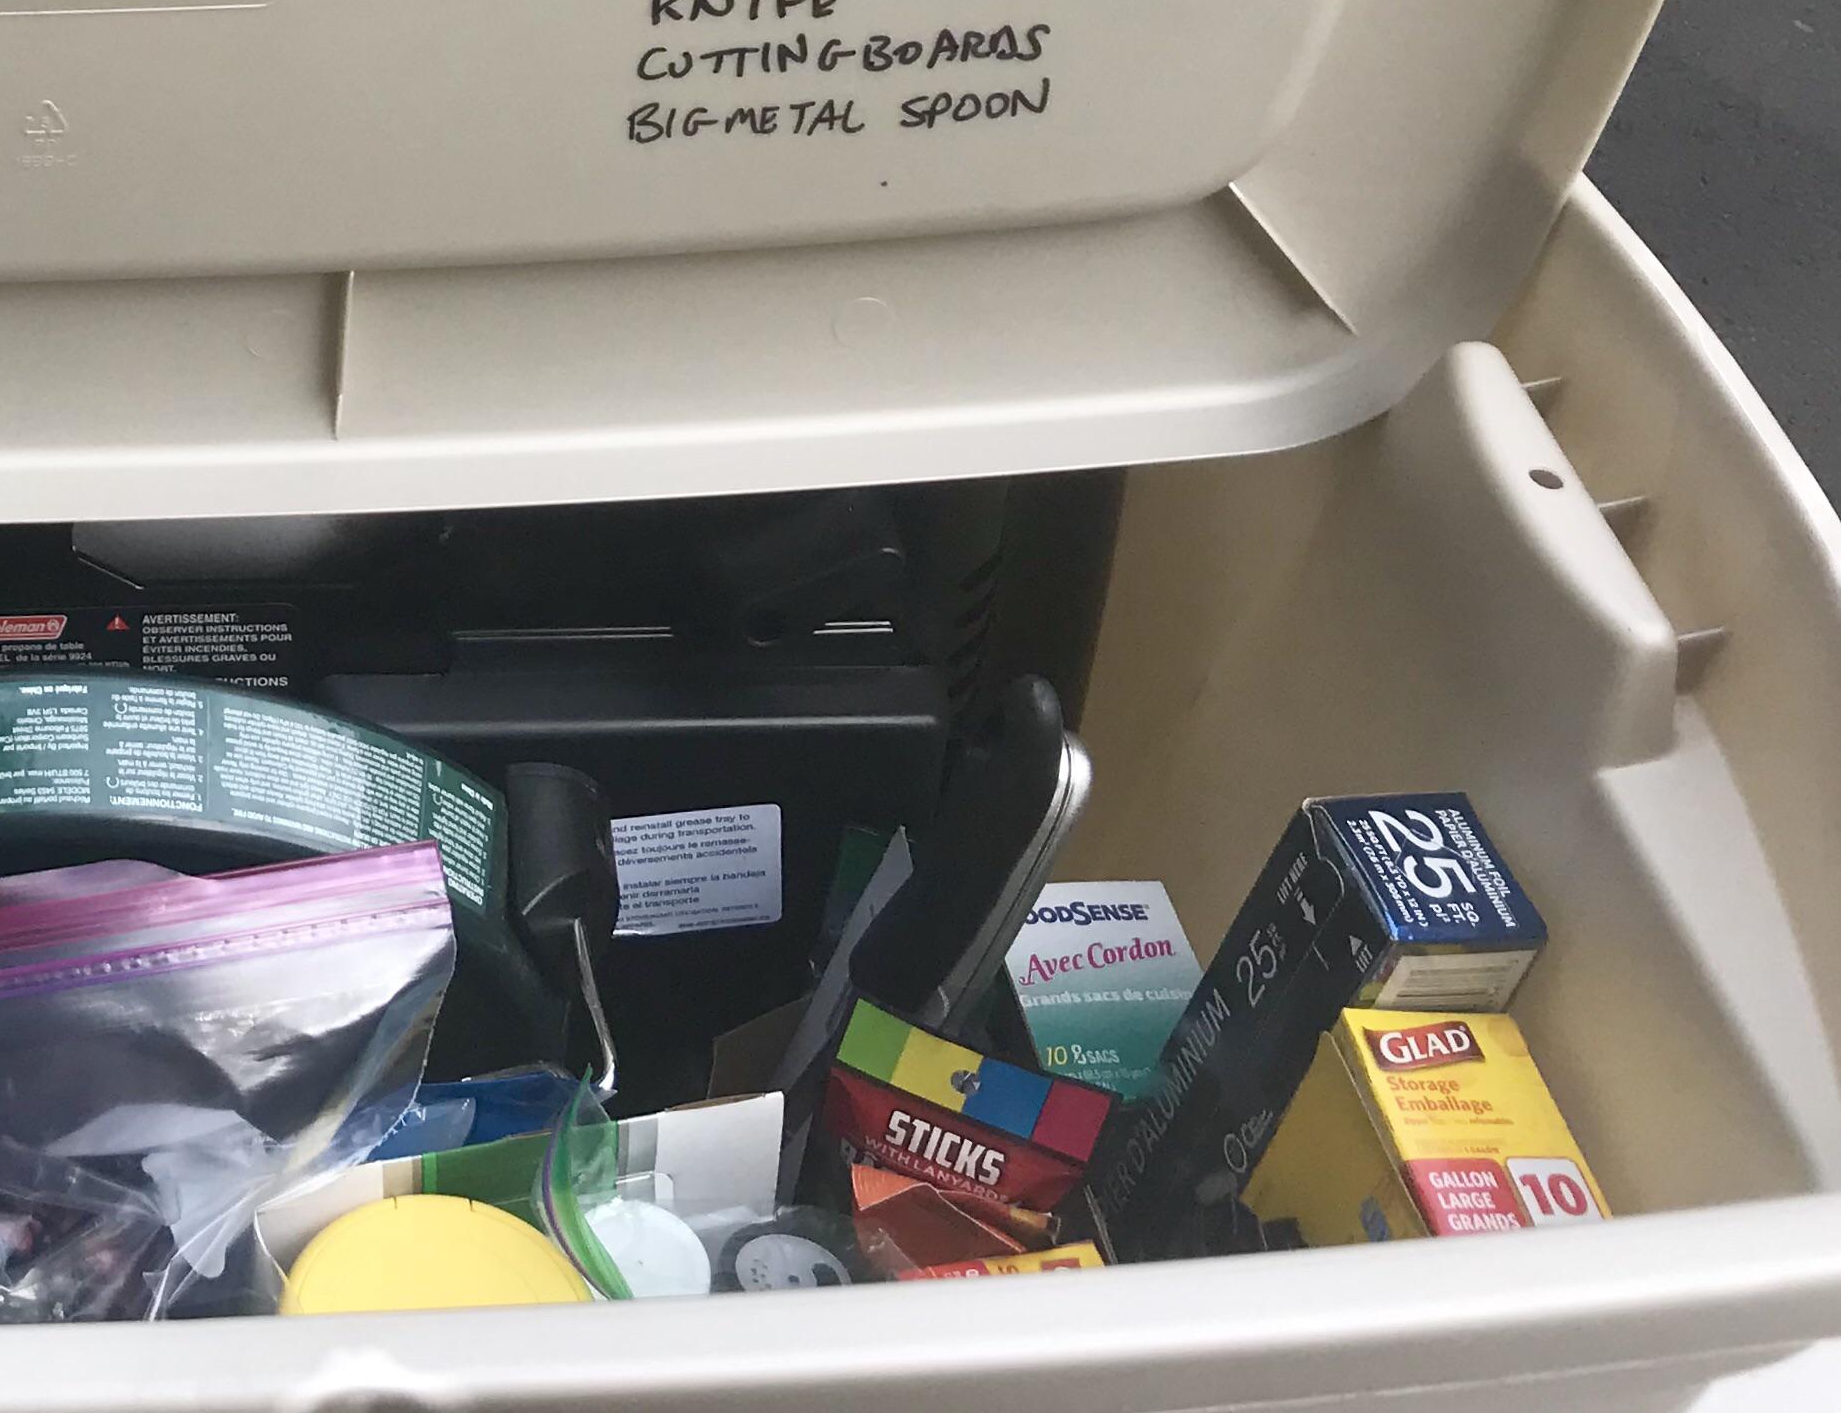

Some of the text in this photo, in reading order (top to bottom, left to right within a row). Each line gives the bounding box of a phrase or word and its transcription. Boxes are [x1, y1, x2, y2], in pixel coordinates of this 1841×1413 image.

[899, 77, 1051, 131] SPOON
[142, 613, 239, 624] AVERTISSEMENT:
[142, 624, 288, 634] OBSERVER INSTRUCTIONS
[45, 642, 57, 651] de
[59, 641, 84, 650] table
[143, 633, 292, 644] ET AVERTISSEMENTS POUR
[16, 653, 28, 662] de
[31, 653, 40, 661] la
[142, 644, 182, 653] ÉVITER
[143, 653, 276, 663] BLESSURES GRAVES OU
[630, 820, 672, 832] reinstall
[676, 817, 712, 828] grease
[715, 815, 735, 824] tray
[640, 831, 675, 841] during
[642, 843, 685, 854] toujours
[1368, 809, 1476, 899] 25
[1448, 808, 1511, 898] ALUMINUM FOIL
[1435, 810, 1517, 928] PAPIER D'ALUMINIUM
[665, 876, 707, 888] siempre
[645, 897, 700, 909] transporte
[1447, 903, 1465, 924] FT.
[1460, 902, 1480, 928] SQ.
[1018, 937, 1176, 986] Avec Cordon
[1355, 944, 1373, 973] LIFT
[1236, 929, 1277, 1008] 25
[1019, 988, 1143, 1008] Grands sacs de
[1379, 1028, 1472, 1064] GLAD
[1046, 1046, 1120, 1067] 10 SACS
[1386, 1076, 1460, 1093] Storage
[1396, 1096, 1493, 1114] Emballage
[864, 1135, 910, 1167] WITH
[884, 1109, 1006, 1186] STICKS
[1428, 1171, 1498, 1189] GALLON
[1437, 1191, 1496, 1210] LARGE
[1518, 1173, 1588, 1216] 10
[1447, 1213, 1521, 1231] GRANDS
